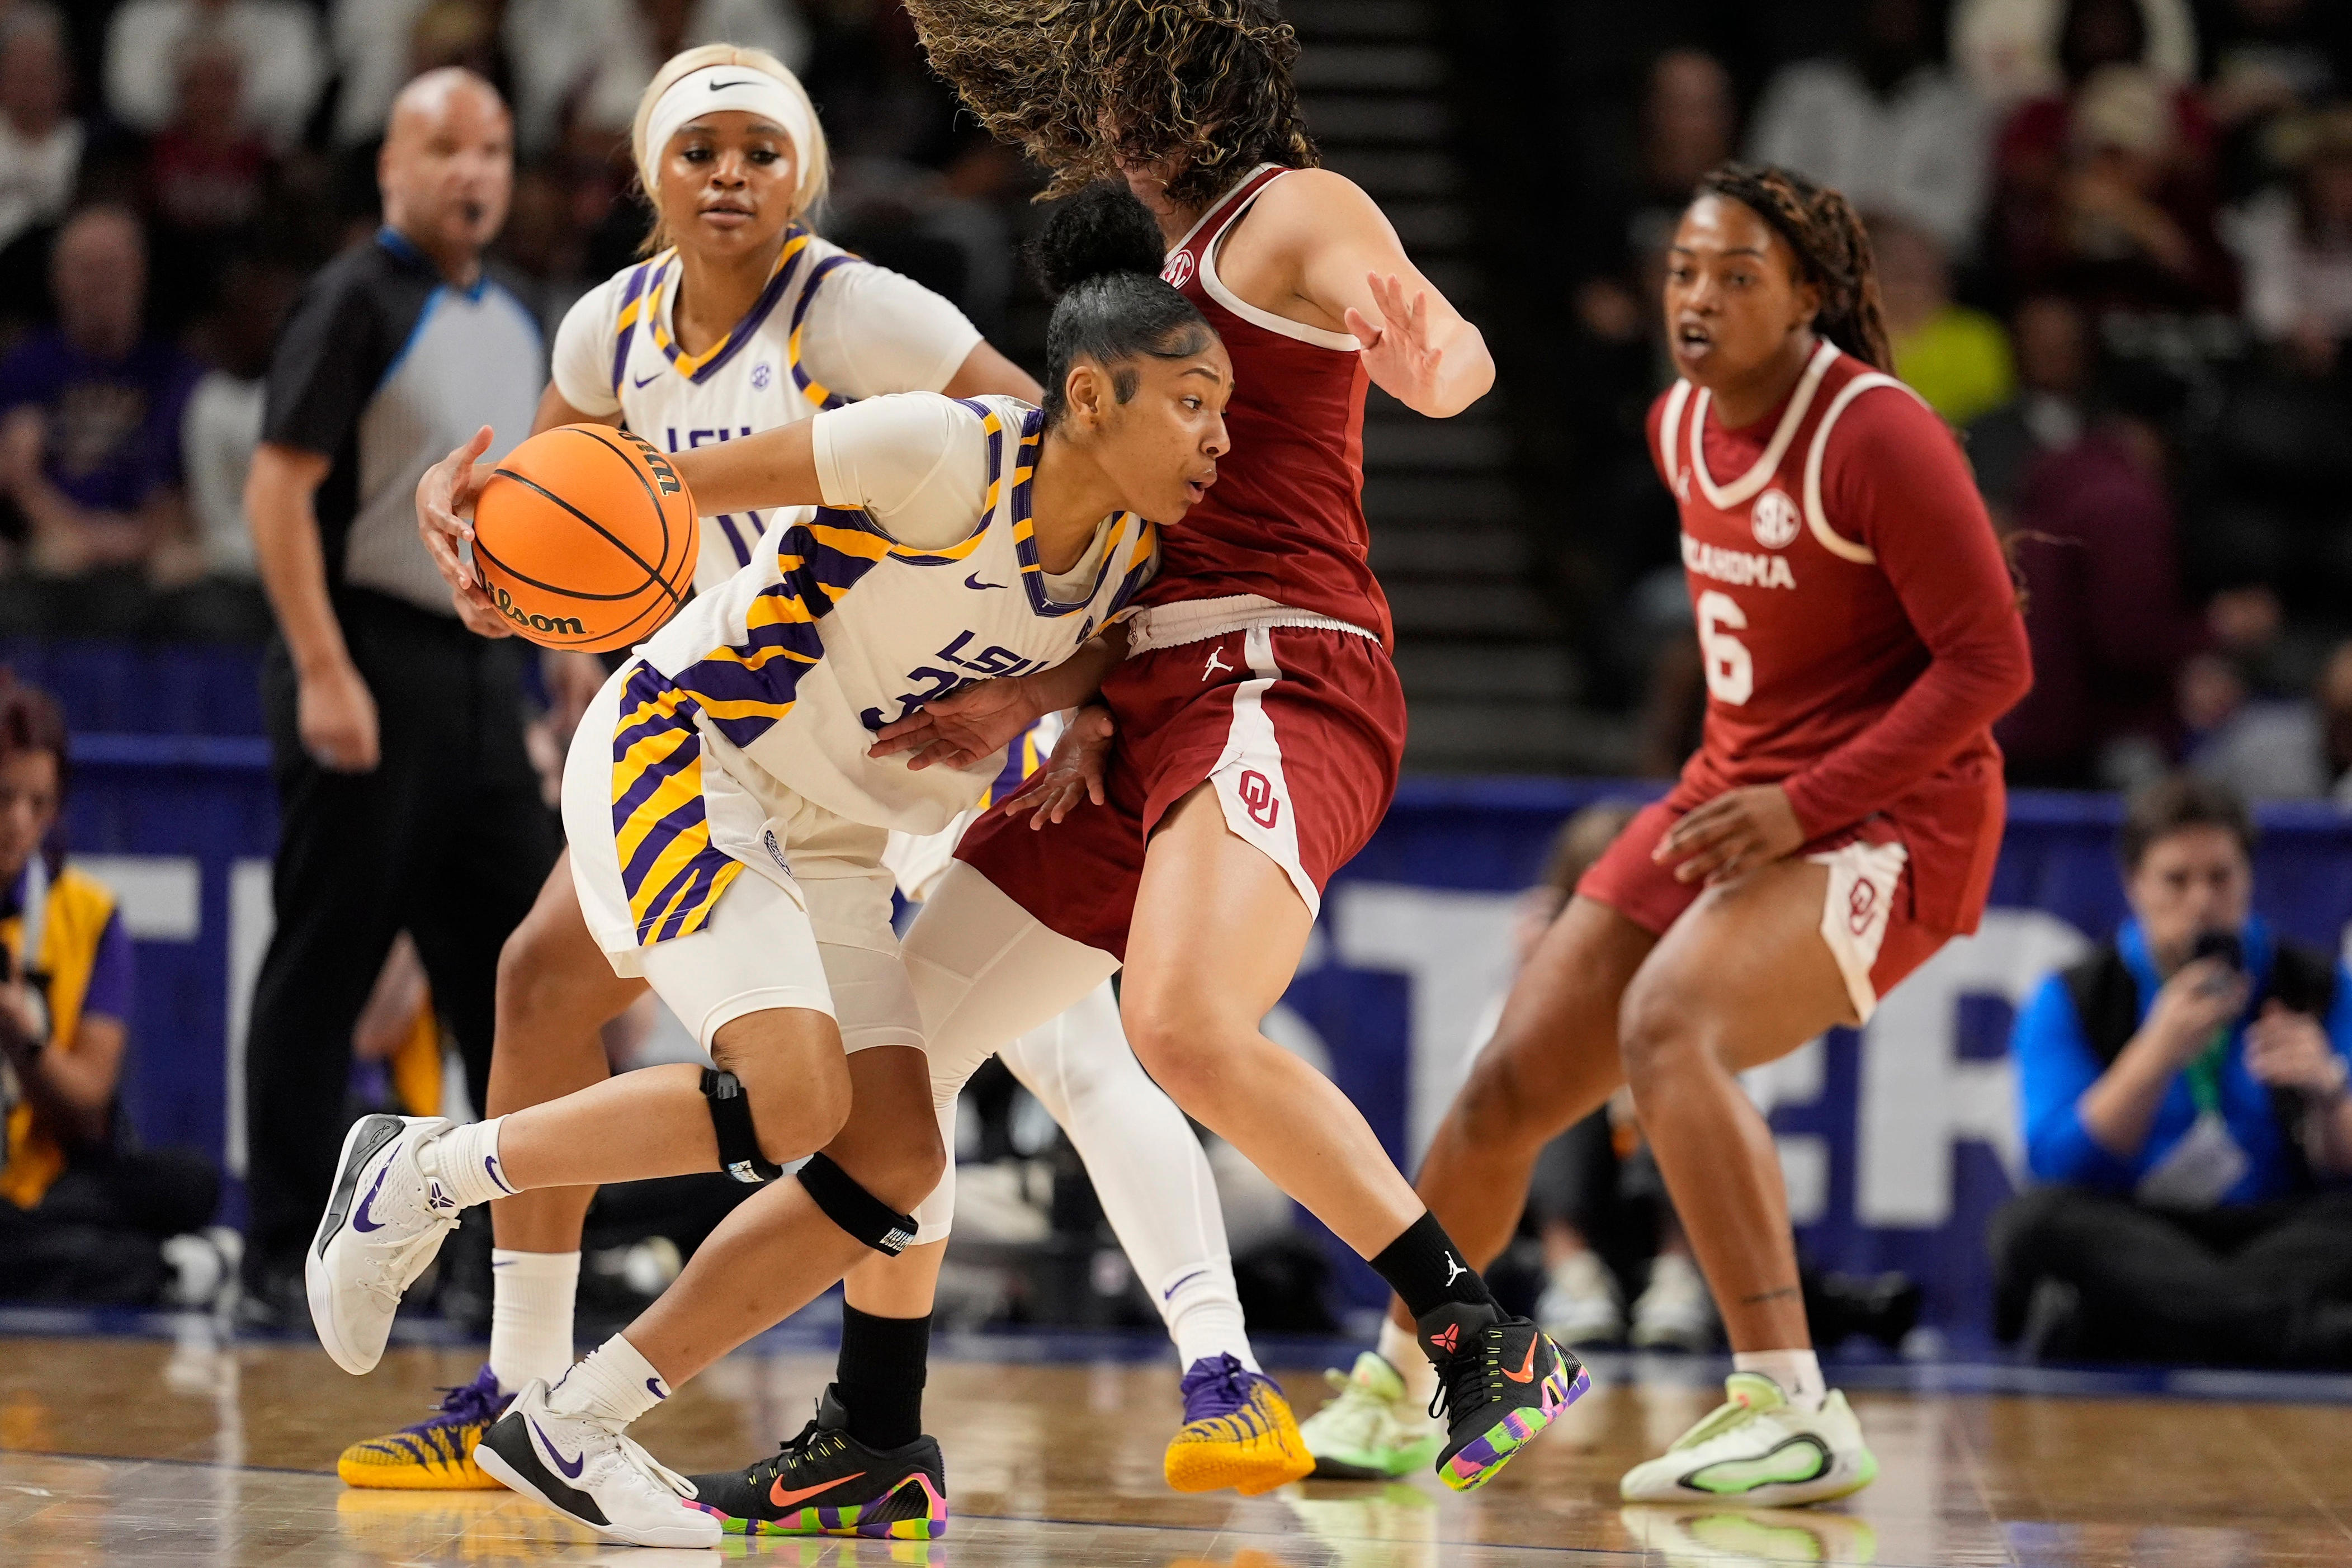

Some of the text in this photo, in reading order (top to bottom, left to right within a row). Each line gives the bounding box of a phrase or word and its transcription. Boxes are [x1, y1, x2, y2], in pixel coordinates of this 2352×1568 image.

[473, 560, 587, 635] ilson
[1696, 589, 1754, 706] 6
[1239, 769, 1279, 829] OU
